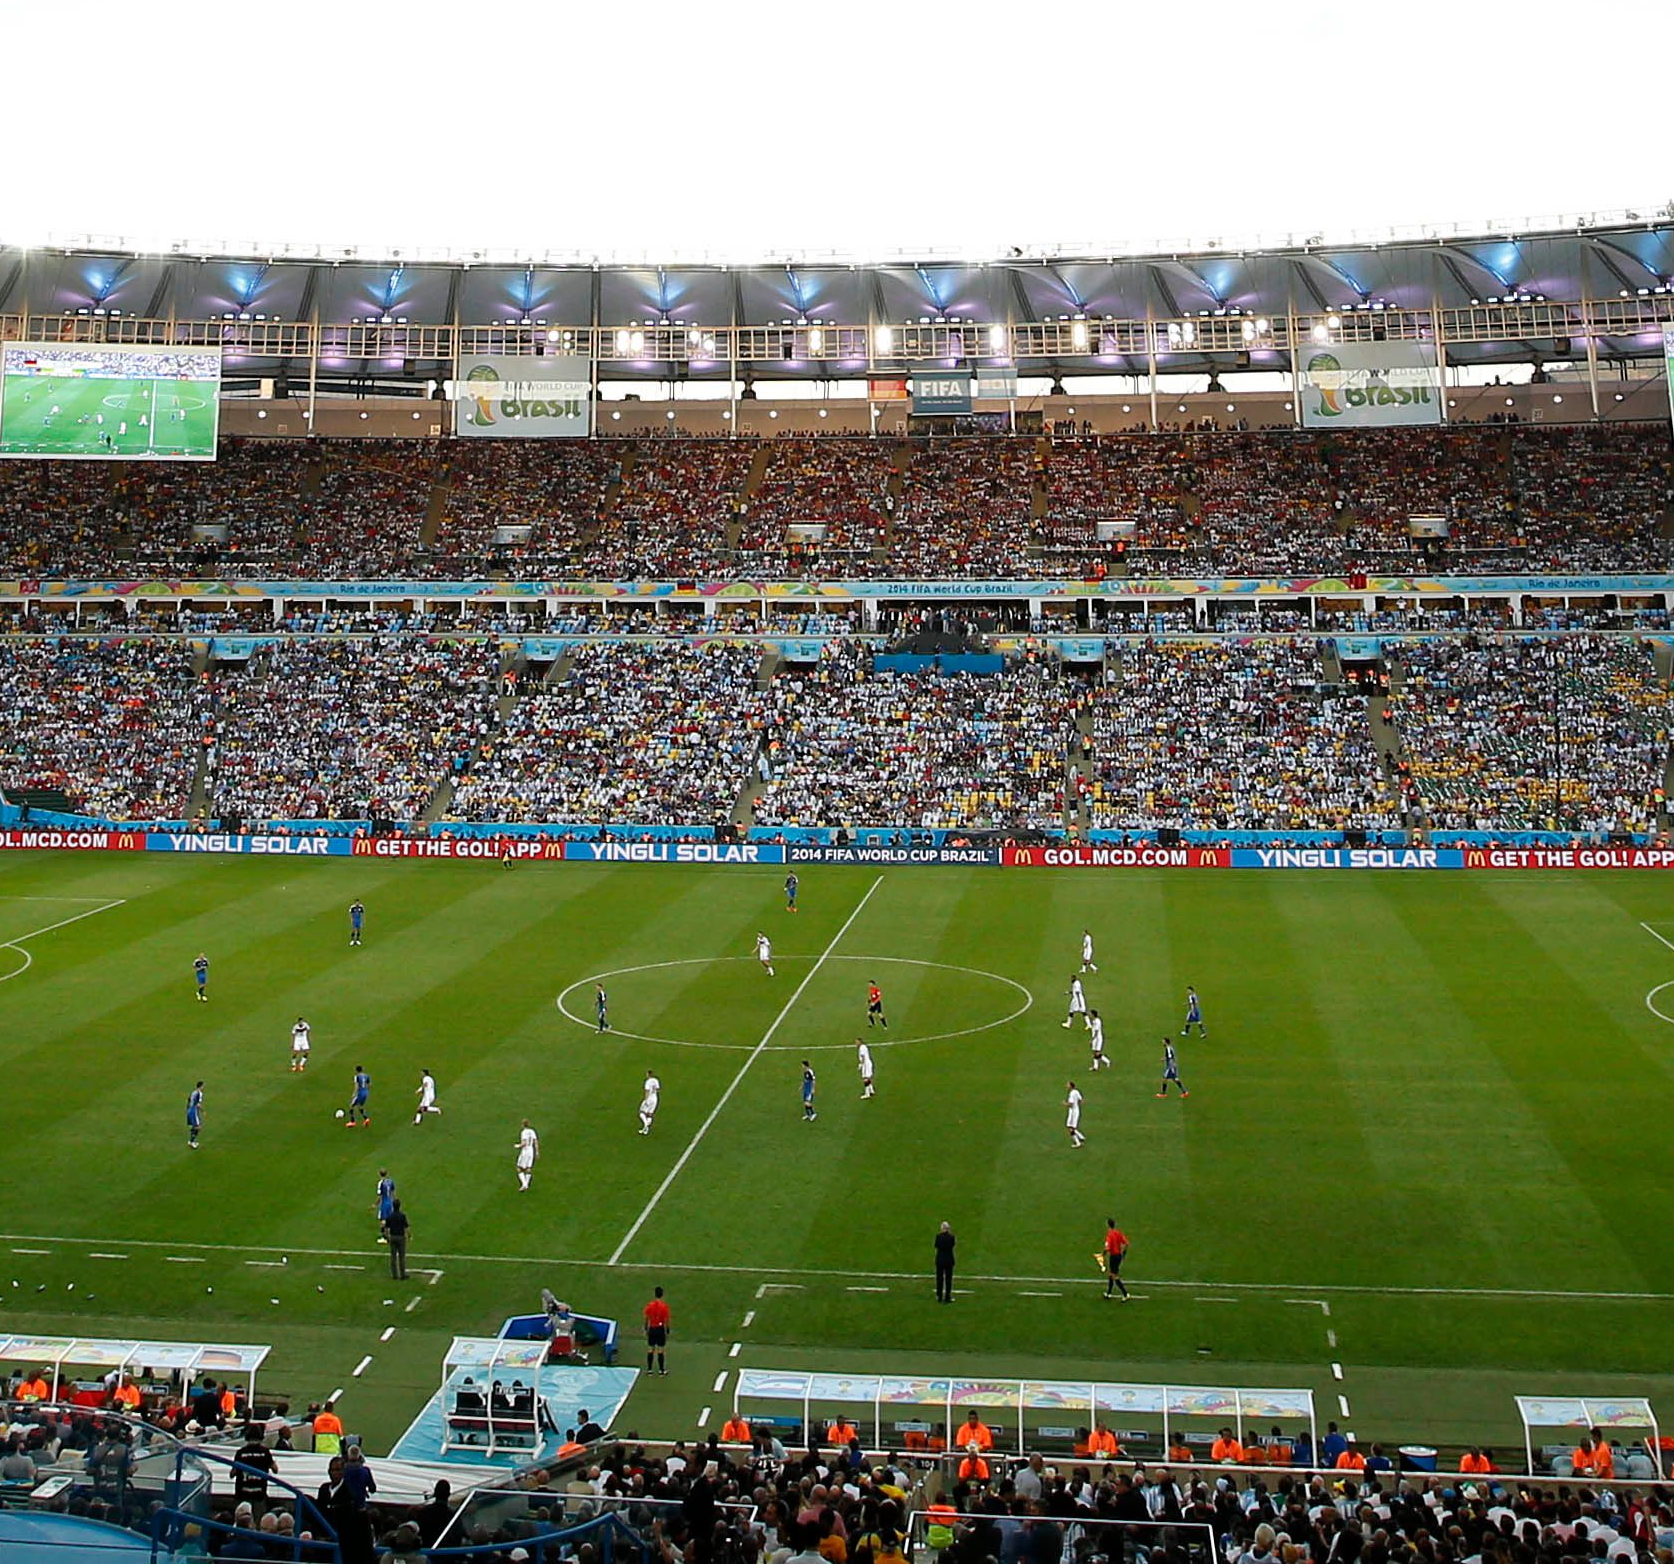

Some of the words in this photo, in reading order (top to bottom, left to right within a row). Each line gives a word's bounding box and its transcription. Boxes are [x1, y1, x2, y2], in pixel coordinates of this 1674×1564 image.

[921, 379, 962, 397] FIFA
[170, 836, 243, 853] YINGLI
[250, 837, 328, 854] SOLAR
[376, 840, 412, 856] GET
[415, 840, 451, 857] THE
[454, 840, 499, 858] GOL!
[591, 843, 667, 861] YINGLI
[677, 844, 759, 862] SOLAR
[791, 847, 822, 861] 2014
[825, 847, 855, 861] FIFA
[858, 848, 906, 862] WORLD
[909, 848, 937, 862] CUP
[1043, 848, 1188, 866] GOL.MCD.COM
[1258, 849, 1341, 868] YINGLI
[1350, 849, 1437, 868] SOLAR
[1489, 850, 1529, 867] GET
[1534, 850, 1575, 867] THE
[1578, 850, 1629, 868] GOL!
[1632, 851, 1674, 868] APP
